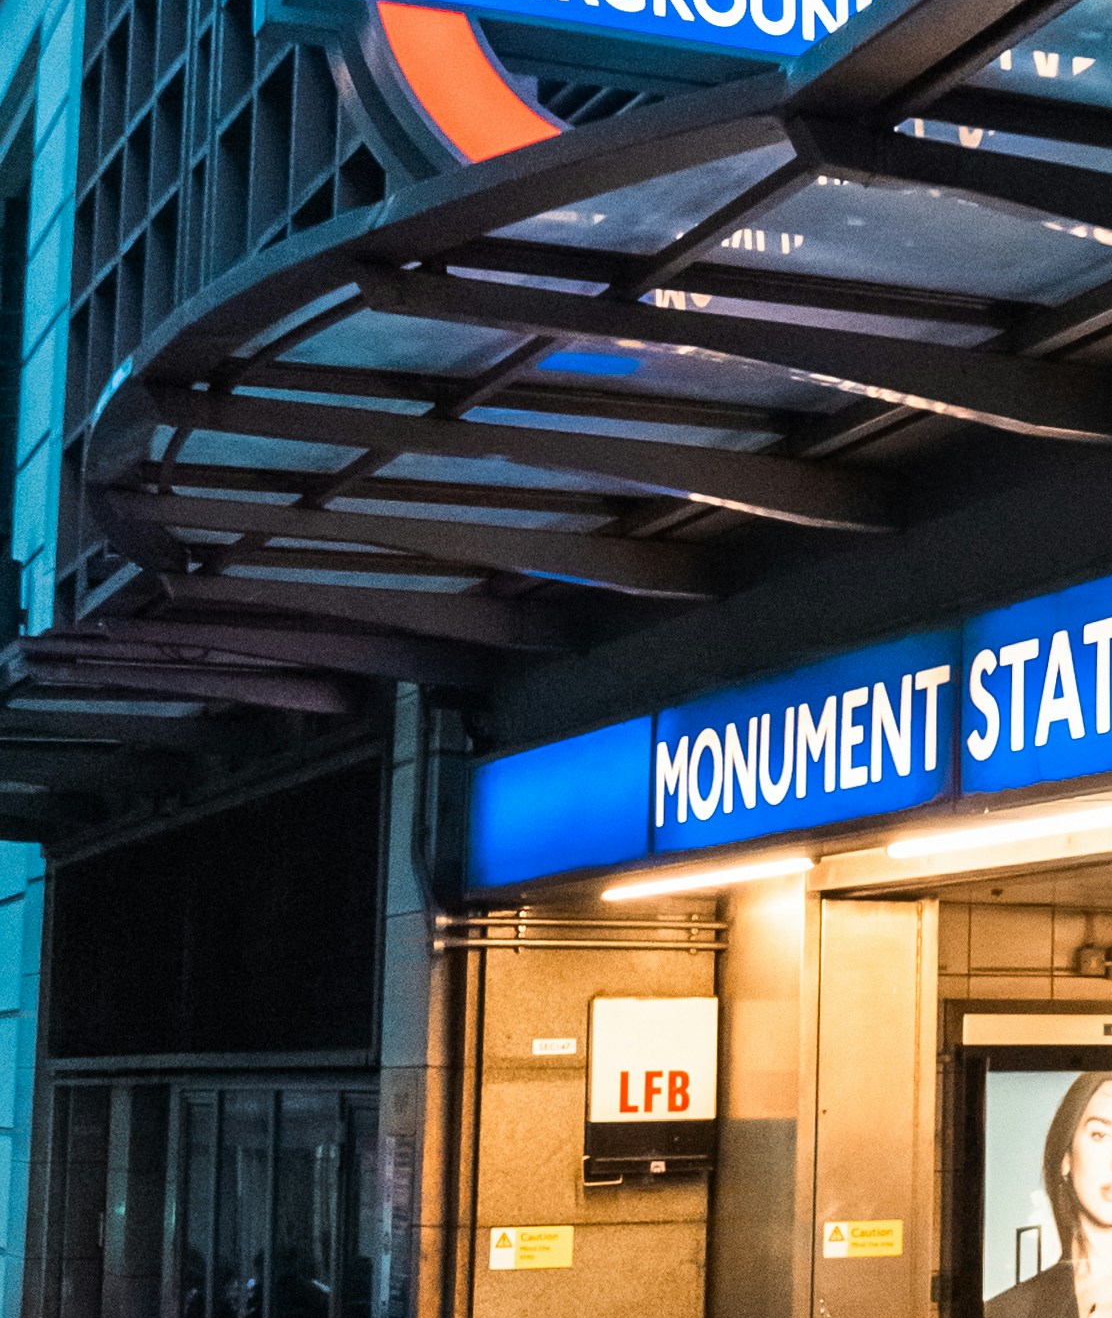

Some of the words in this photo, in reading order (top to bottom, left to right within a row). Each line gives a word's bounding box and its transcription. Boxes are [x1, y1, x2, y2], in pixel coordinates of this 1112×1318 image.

[656, 665, 951, 828] MONUMENT
[619, 1070, 690, 1113] LFB
[520, 1233, 559, 1242] Caution
[851, 1228, 894, 1238] Caution
